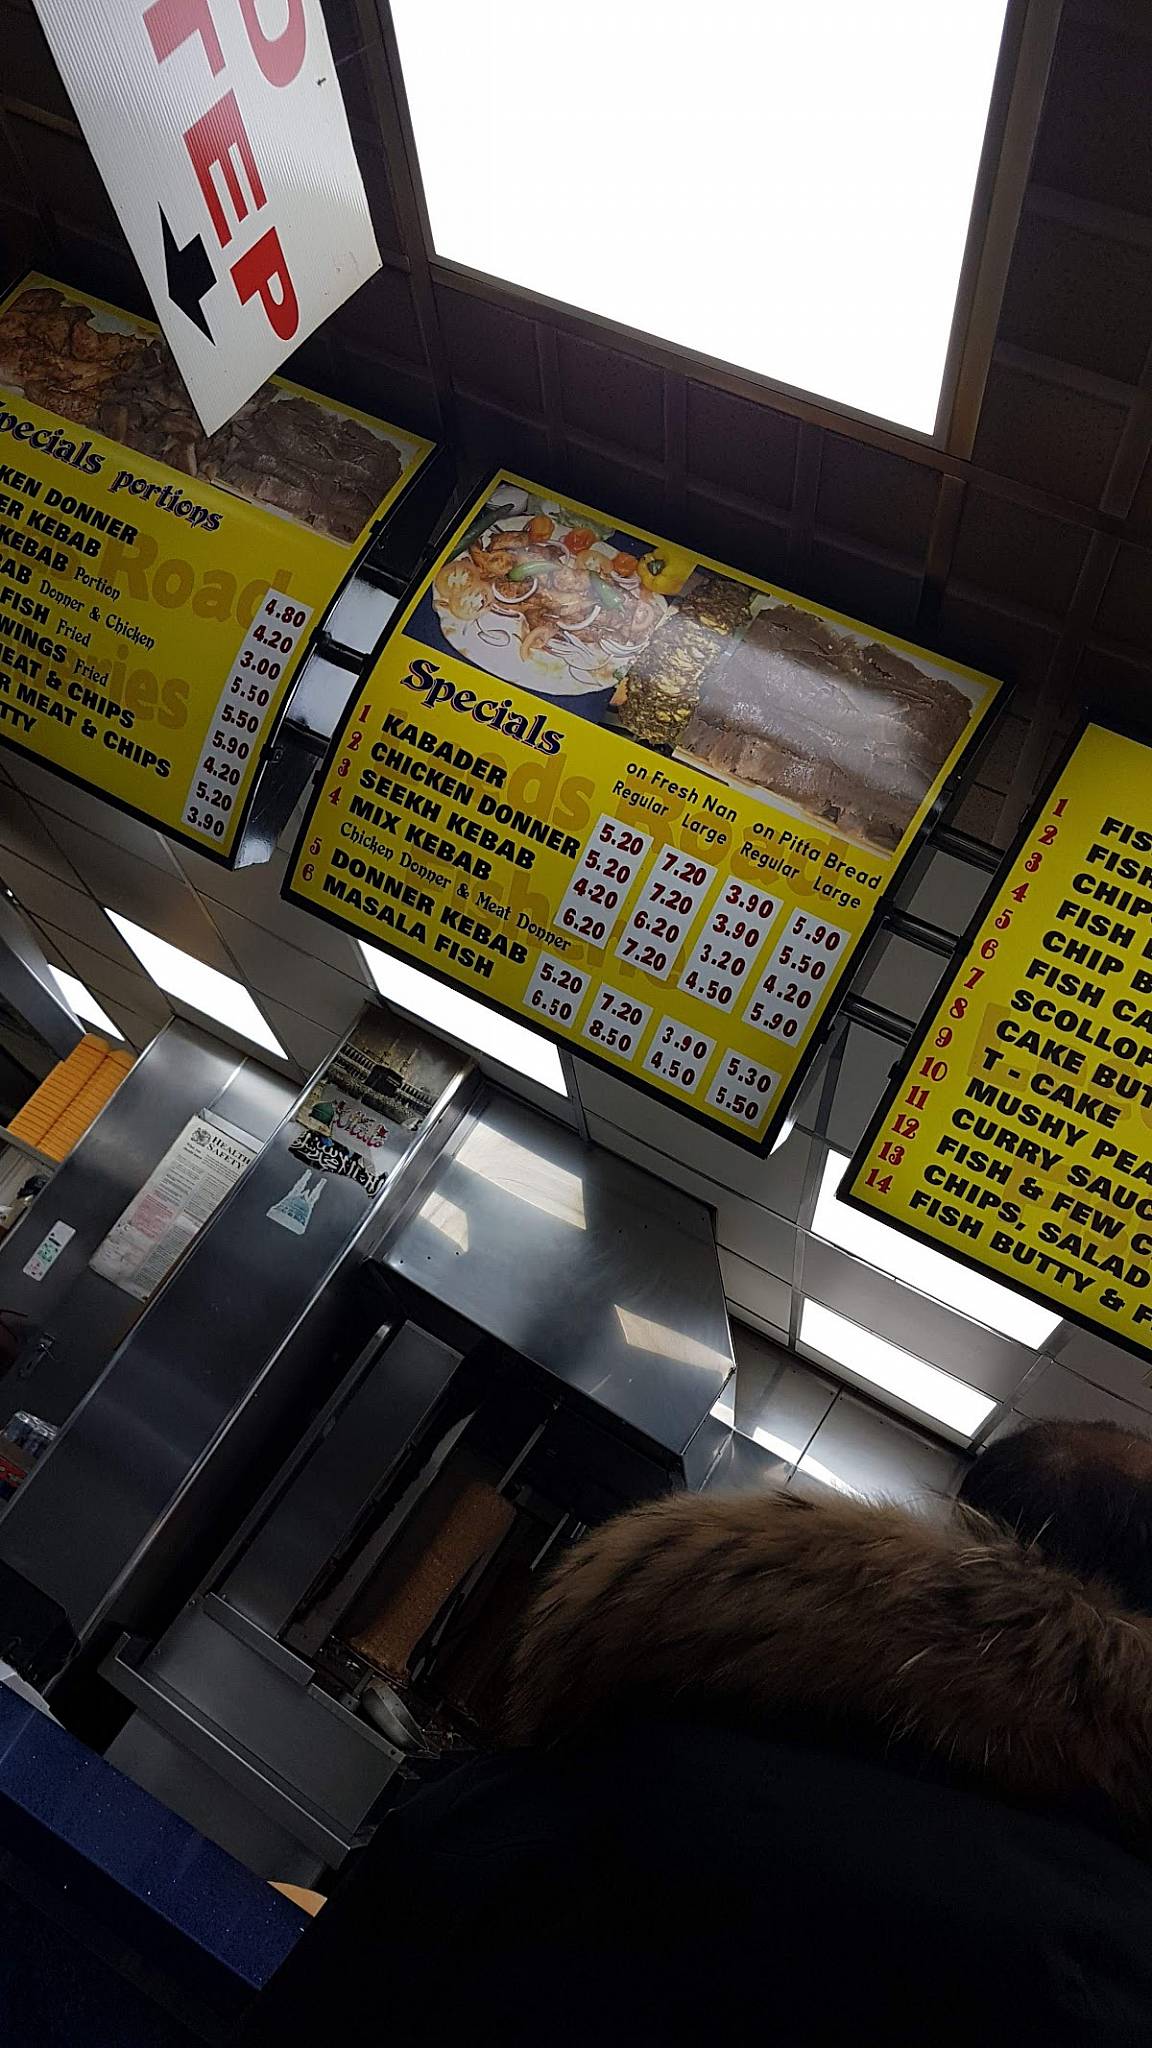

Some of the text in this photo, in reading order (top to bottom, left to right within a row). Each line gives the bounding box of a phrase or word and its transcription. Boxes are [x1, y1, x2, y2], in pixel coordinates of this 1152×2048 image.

[0, 401, 224, 533] pecials portions
[27, 510, 102, 557] KEBAB
[44, 488, 139, 546] DONNER
[0, 554, 156, 650] AB Donner & Chicken
[0, 586, 91, 647] FISH Fried
[74, 567, 120, 603] Portion
[265, 599, 306, 628] 4.80
[0, 614, 109, 687] WINGS Fried
[240, 651, 281, 680] 3.00
[252, 624, 293, 654] 4.20
[0, 642, 42, 680] EAT
[46, 671, 61, 690] &
[68, 682, 136, 730] CHIPS
[221, 704, 259, 733] 5.50
[230, 676, 270, 707] 5.50
[401, 658, 565, 755] Specials
[16, 683, 77, 727] MEAT
[82, 718, 97, 739] &
[103, 730, 172, 778] CHIPS
[212, 729, 249, 760] 5.90
[358, 704, 508, 789] 1 KABADER
[195, 782, 232, 812] 5.20
[203, 755, 240, 786] 4.20
[347, 731, 581, 860] 2 CHICKEN DONNER
[626, 762, 737, 824] on Fresh Nan
[186, 806, 225, 837] 3.90
[328, 786, 493, 881] 4 MIX KEBAB
[338, 758, 536, 870] 3 SEEKH KEBAB
[612, 780, 728, 847] Regular Large
[1037, 825, 1057, 845] 2
[1053, 799, 1069, 817] 1
[340, 821, 571, 953] Chicken Donner & Meat Donner
[599, 823, 841, 952] 5.20 7.20 3.90 5.90
[740, 841, 862, 911] Regular Large
[752, 821, 882, 891] on Pitta Bread
[1025, 852, 1042, 872] 3
[302, 863, 496, 979] 6 MASALA FISH
[309, 837, 322, 857] 5
[331, 847, 436, 917] DONNER
[440, 906, 529, 965] KEBAB
[584, 850, 826, 981] 5.20 7.20 3.90 5.50
[1012, 882, 1030, 903] 4
[1056, 899, 1136, 949] FISH
[562, 907, 798, 1038] 6.20 7.20 4.50 5.90
[573, 877, 812, 1011] 4.20 6.20 3.20 4.20
[980, 938, 999, 959] 6
[1025, 958, 1105, 1008] FISH
[995, 909, 1013, 929] 5
[1042, 930, 1124, 976] CHIP
[964, 967, 985, 989] 7
[531, 990, 759, 1120] 6.50 8.50 4.50 5.50
[540, 962, 772, 1093] 5.20 7.20 3.90 5.30
[935, 1027, 953, 1047] 9
[949, 997, 968, 1019] 8
[996, 1019, 1086, 1075] CAKE
[905, 1086, 930, 1110] 11
[952, 1108, 1063, 1172] CURRY
[919, 1056, 948, 1081] 10
[964, 1077, 1089, 1147] MUSHY
[206, 1143, 244, 1169] SAFETY
[211, 1136, 251, 1164] HEALTH
[890, 1114, 919, 1139] 12
[935, 1134, 1012, 1185] FISH
[1018, 1176, 1044, 1201] &
[1050, 1192, 1126, 1239] FEW
[864, 1168, 894, 1194] 14
[908, 1189, 984, 1239] FISH
[989, 1230, 1096, 1293] BUTTY
[1099, 1288, 1125, 1312] &
[878, 1141, 1150, 1288] 13 CHIPS, SALAD
